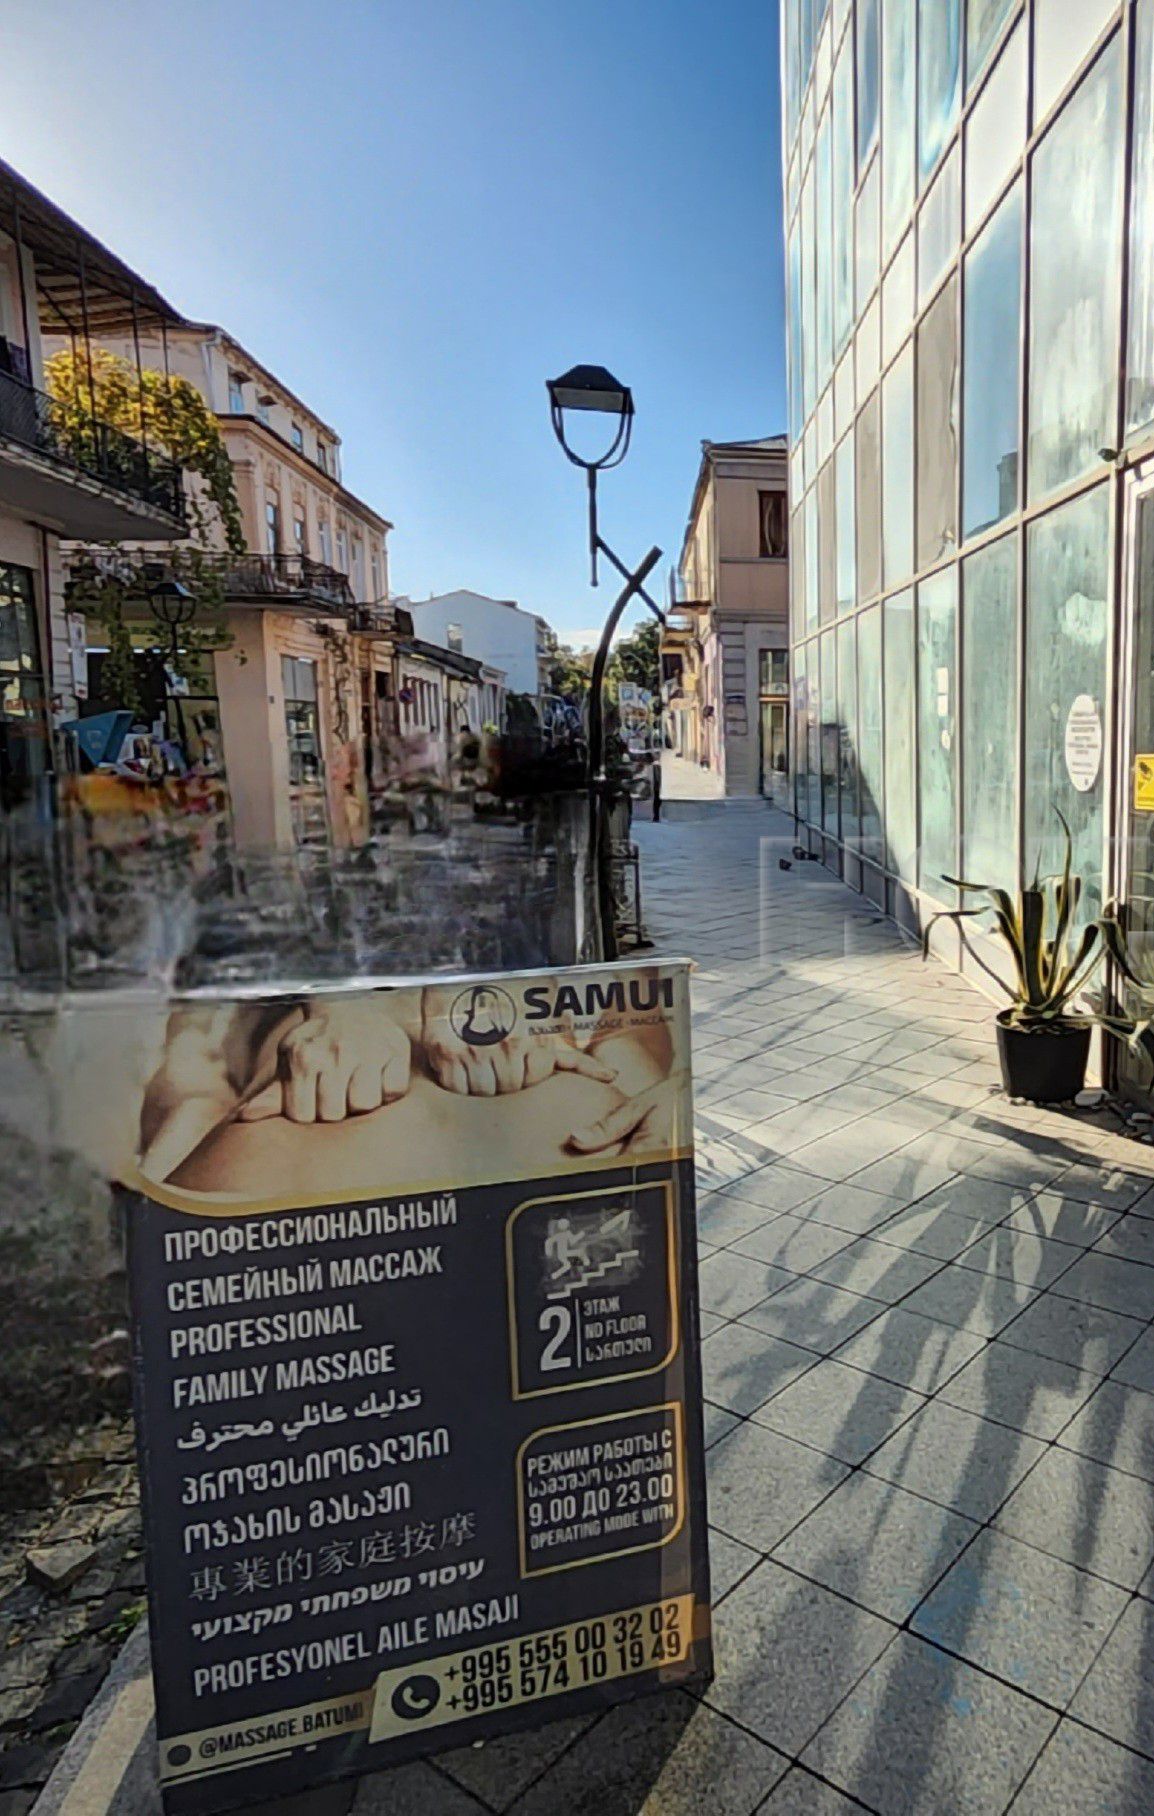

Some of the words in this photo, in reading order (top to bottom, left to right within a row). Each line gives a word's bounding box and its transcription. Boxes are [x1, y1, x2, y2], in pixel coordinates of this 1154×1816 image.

[523, 978, 674, 1020] SAMUI
[165, 1193, 457, 1262] ПРОФЕССИОНАЛЬНЫЙ
[168, 1258, 323, 1312] СЕМЕЙНЫЙ
[329, 1246, 443, 1288] МАССАЖ
[583, 1296, 620, 1316] ЭТАЖ
[171, 1303, 362, 1359] PROFESSIONAL
[539, 1305, 572, 1371] 2
[606, 1314, 647, 1334] FLOOR
[174, 1365, 269, 1410] FAMILY
[276, 1345, 396, 1390] MASSAGE
[181, 1428, 450, 1505] პროფესიონალური
[527, 1446, 590, 1478] РЕЖИМ
[593, 1432, 658, 1463] РАБОТЫ
[184, 1506, 301, 1554] ოჯახის
[308, 1482, 411, 1529] მასაჟი
[529, 1495, 576, 1527] 9.00
[582, 1487, 611, 1519] ДО
[616, 1473, 673, 1508] 23.00
[530, 1519, 601, 1550] OPERATING
[604, 1510, 639, 1534] MODE
[641, 1503, 674, 1524] WITH
[188, 1511, 477, 1602] 專業的家庭按摩
[194, 1633, 372, 1697] PROFESYONEL
[377, 1616, 429, 1654] AILE
[435, 1594, 519, 1639] MASAJI
[444, 1646, 511, 1684] +995
[519, 1632, 567, 1666] 555
[574, 1621, 606, 1654] 00
[613, 1612, 643, 1643] 32
[650, 1603, 679, 1634] 02
[446, 1675, 513, 1712] +995
[520, 1659, 569, 1697] 574
[579, 1650, 607, 1683] 10
[616, 1640, 644, 1672] 19
[651, 1630, 681, 1661] 49
